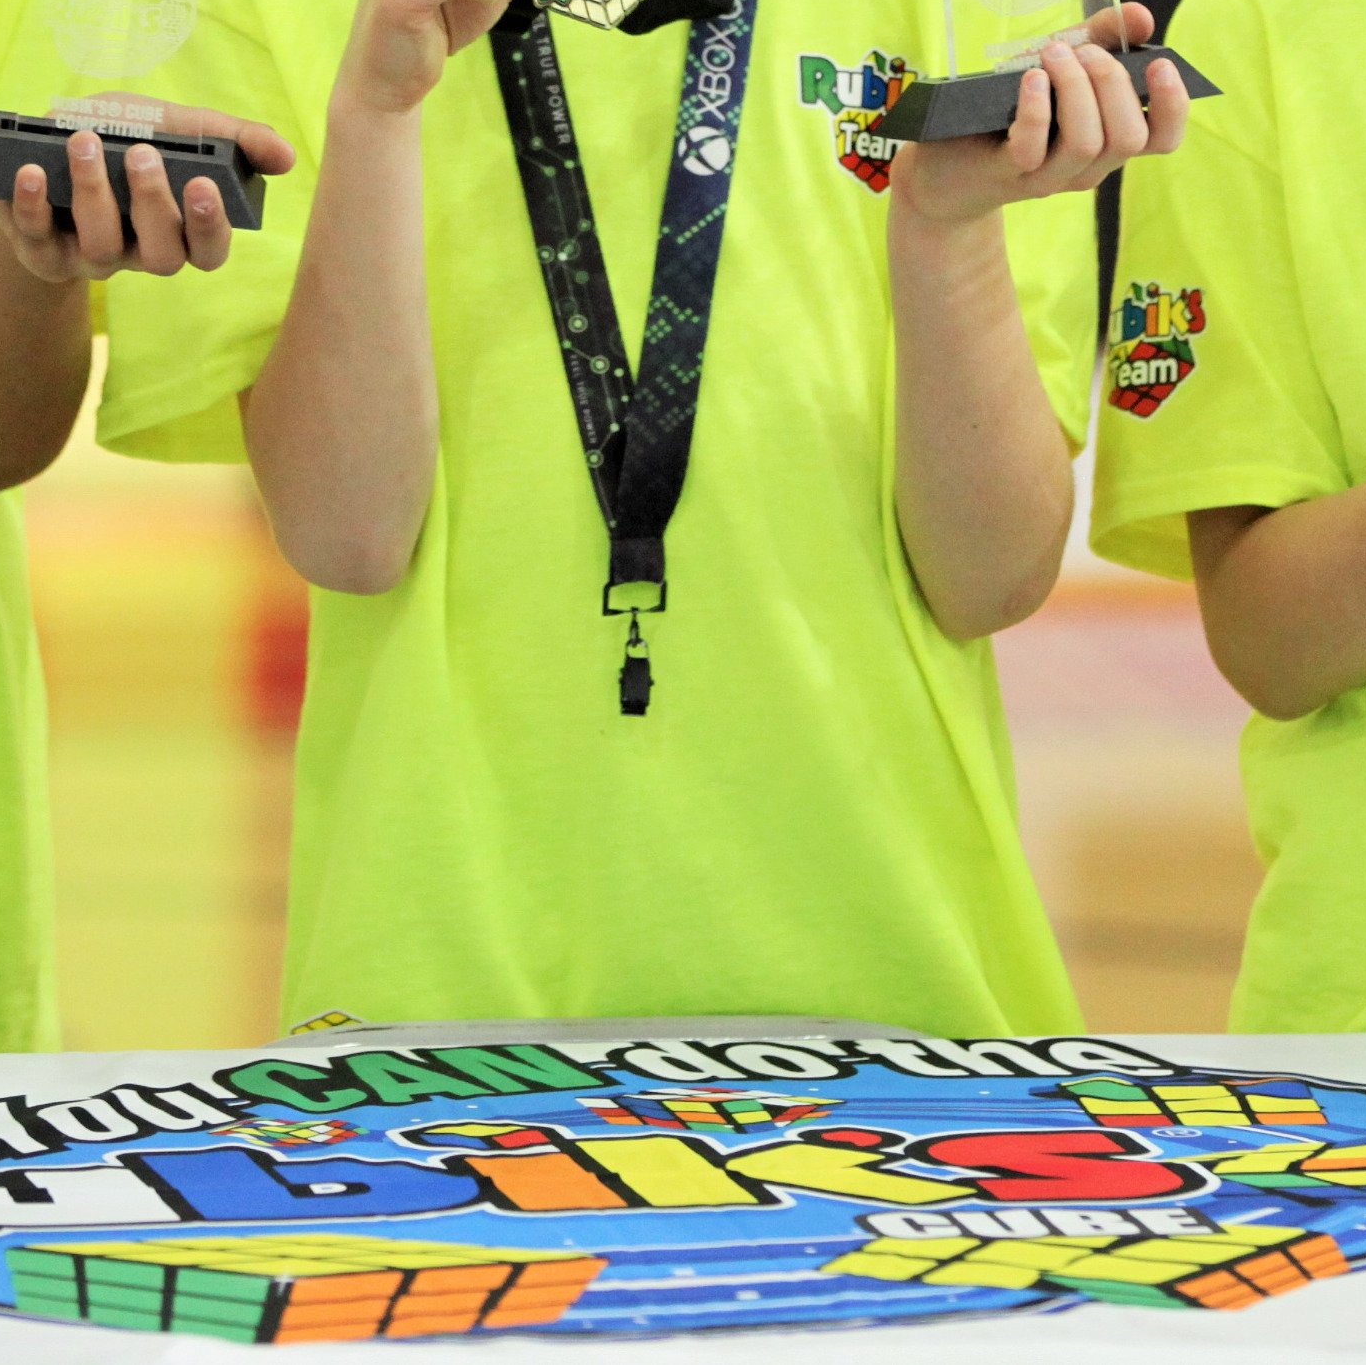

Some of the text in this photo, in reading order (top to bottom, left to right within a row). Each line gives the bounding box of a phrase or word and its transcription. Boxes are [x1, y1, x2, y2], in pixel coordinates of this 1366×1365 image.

[536, 36, 557, 79] TRUE
[696, 21, 737, 123] XBOX
[800, 56, 918, 115] Rubi
[546, 83, 572, 145] POWER
[1110, 283, 1206, 345] ubik's
[223, 1042, 605, 1113] CAN
[622, 1039, 840, 1081] do
[850, 1038, 1180, 1077] the
[865, 1206, 1215, 1239] CUBE
